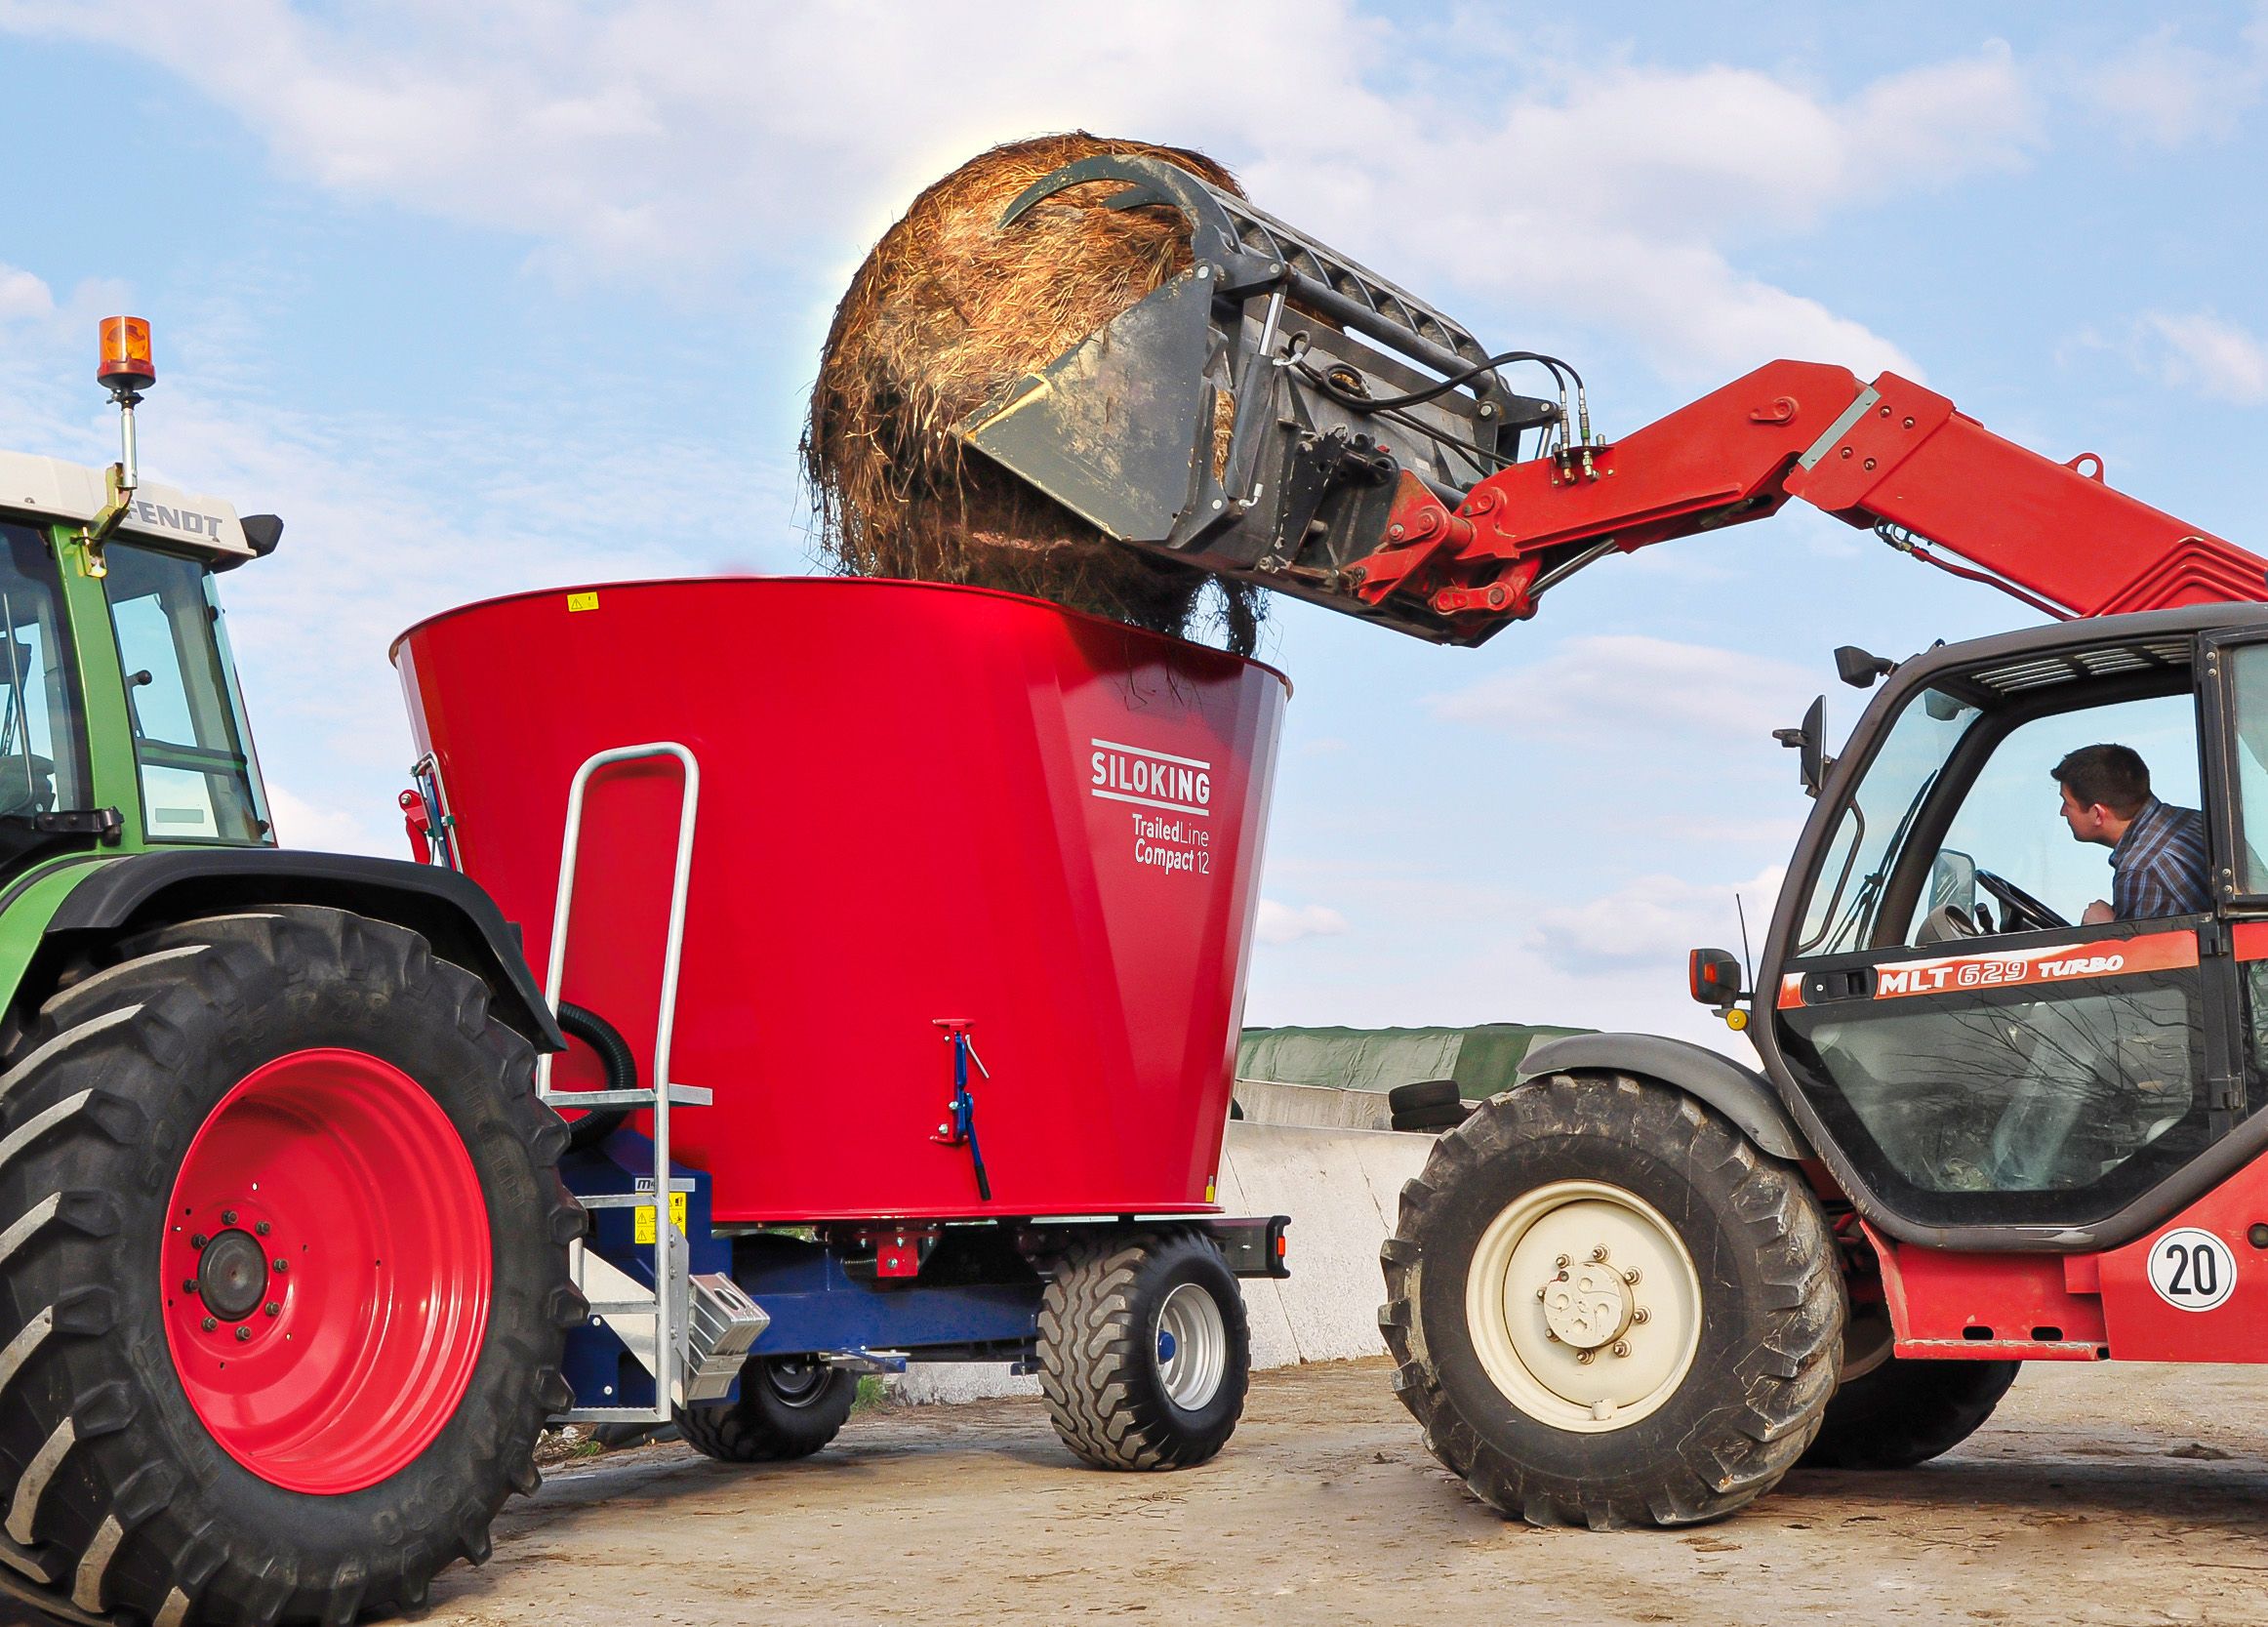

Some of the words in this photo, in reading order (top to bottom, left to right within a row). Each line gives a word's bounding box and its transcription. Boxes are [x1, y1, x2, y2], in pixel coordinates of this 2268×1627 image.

[1092, 752, 1210, 804] SILOKING
[1132, 813, 1209, 847] TrailedLine
[1135, 837, 1195, 875] Compact
[1197, 851, 1210, 875] 12
[1880, 967, 1953, 995] MLT
[1958, 960, 2027, 986] 629
[2039, 956, 2125, 977] TURBO
[2167, 1244, 2217, 1295] 20
